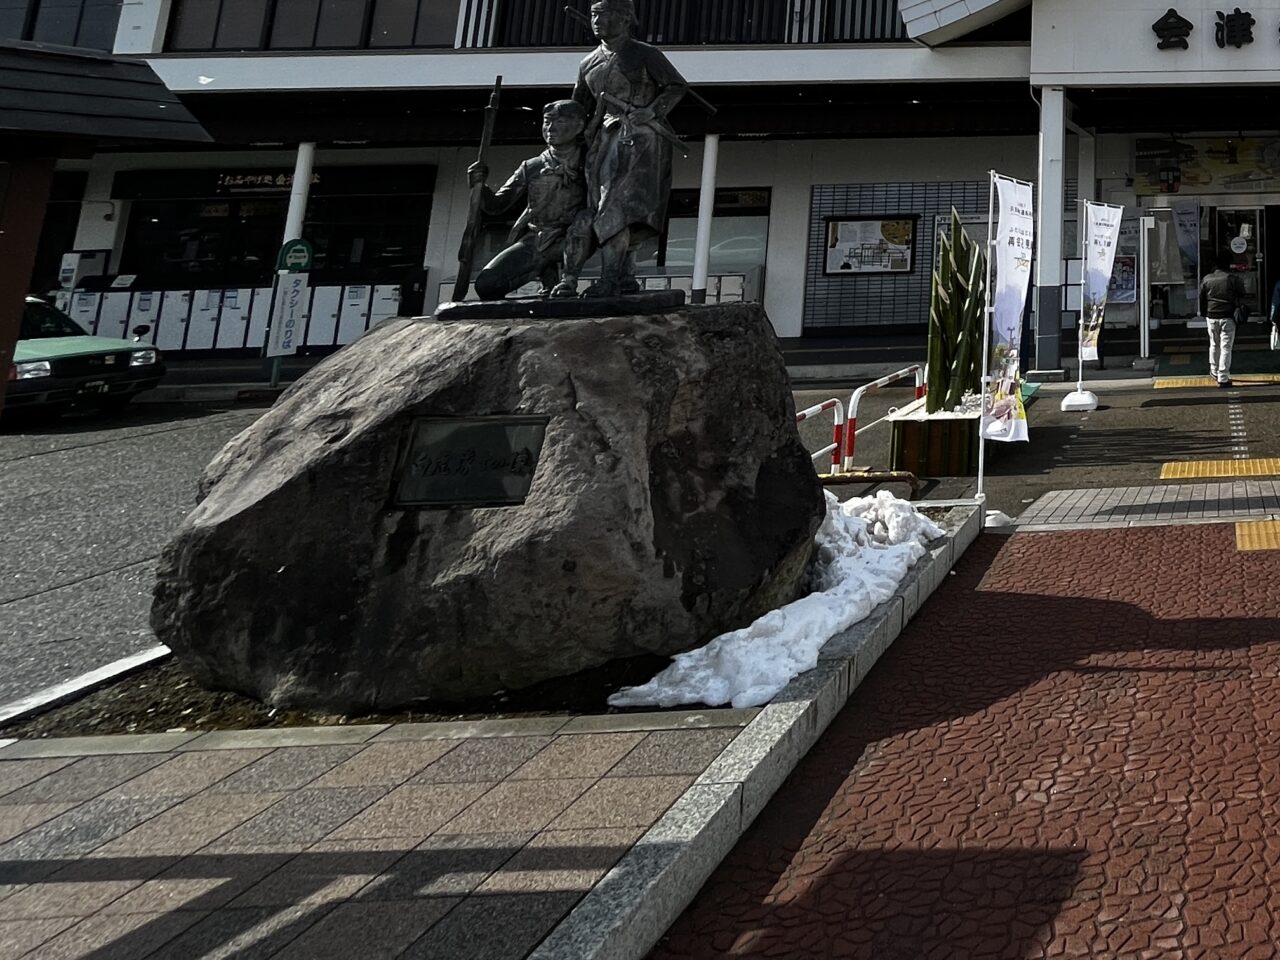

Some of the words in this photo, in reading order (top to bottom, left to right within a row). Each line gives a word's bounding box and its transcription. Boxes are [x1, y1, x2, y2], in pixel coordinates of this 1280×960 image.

[281, 278, 302, 350] タクシーのりば
